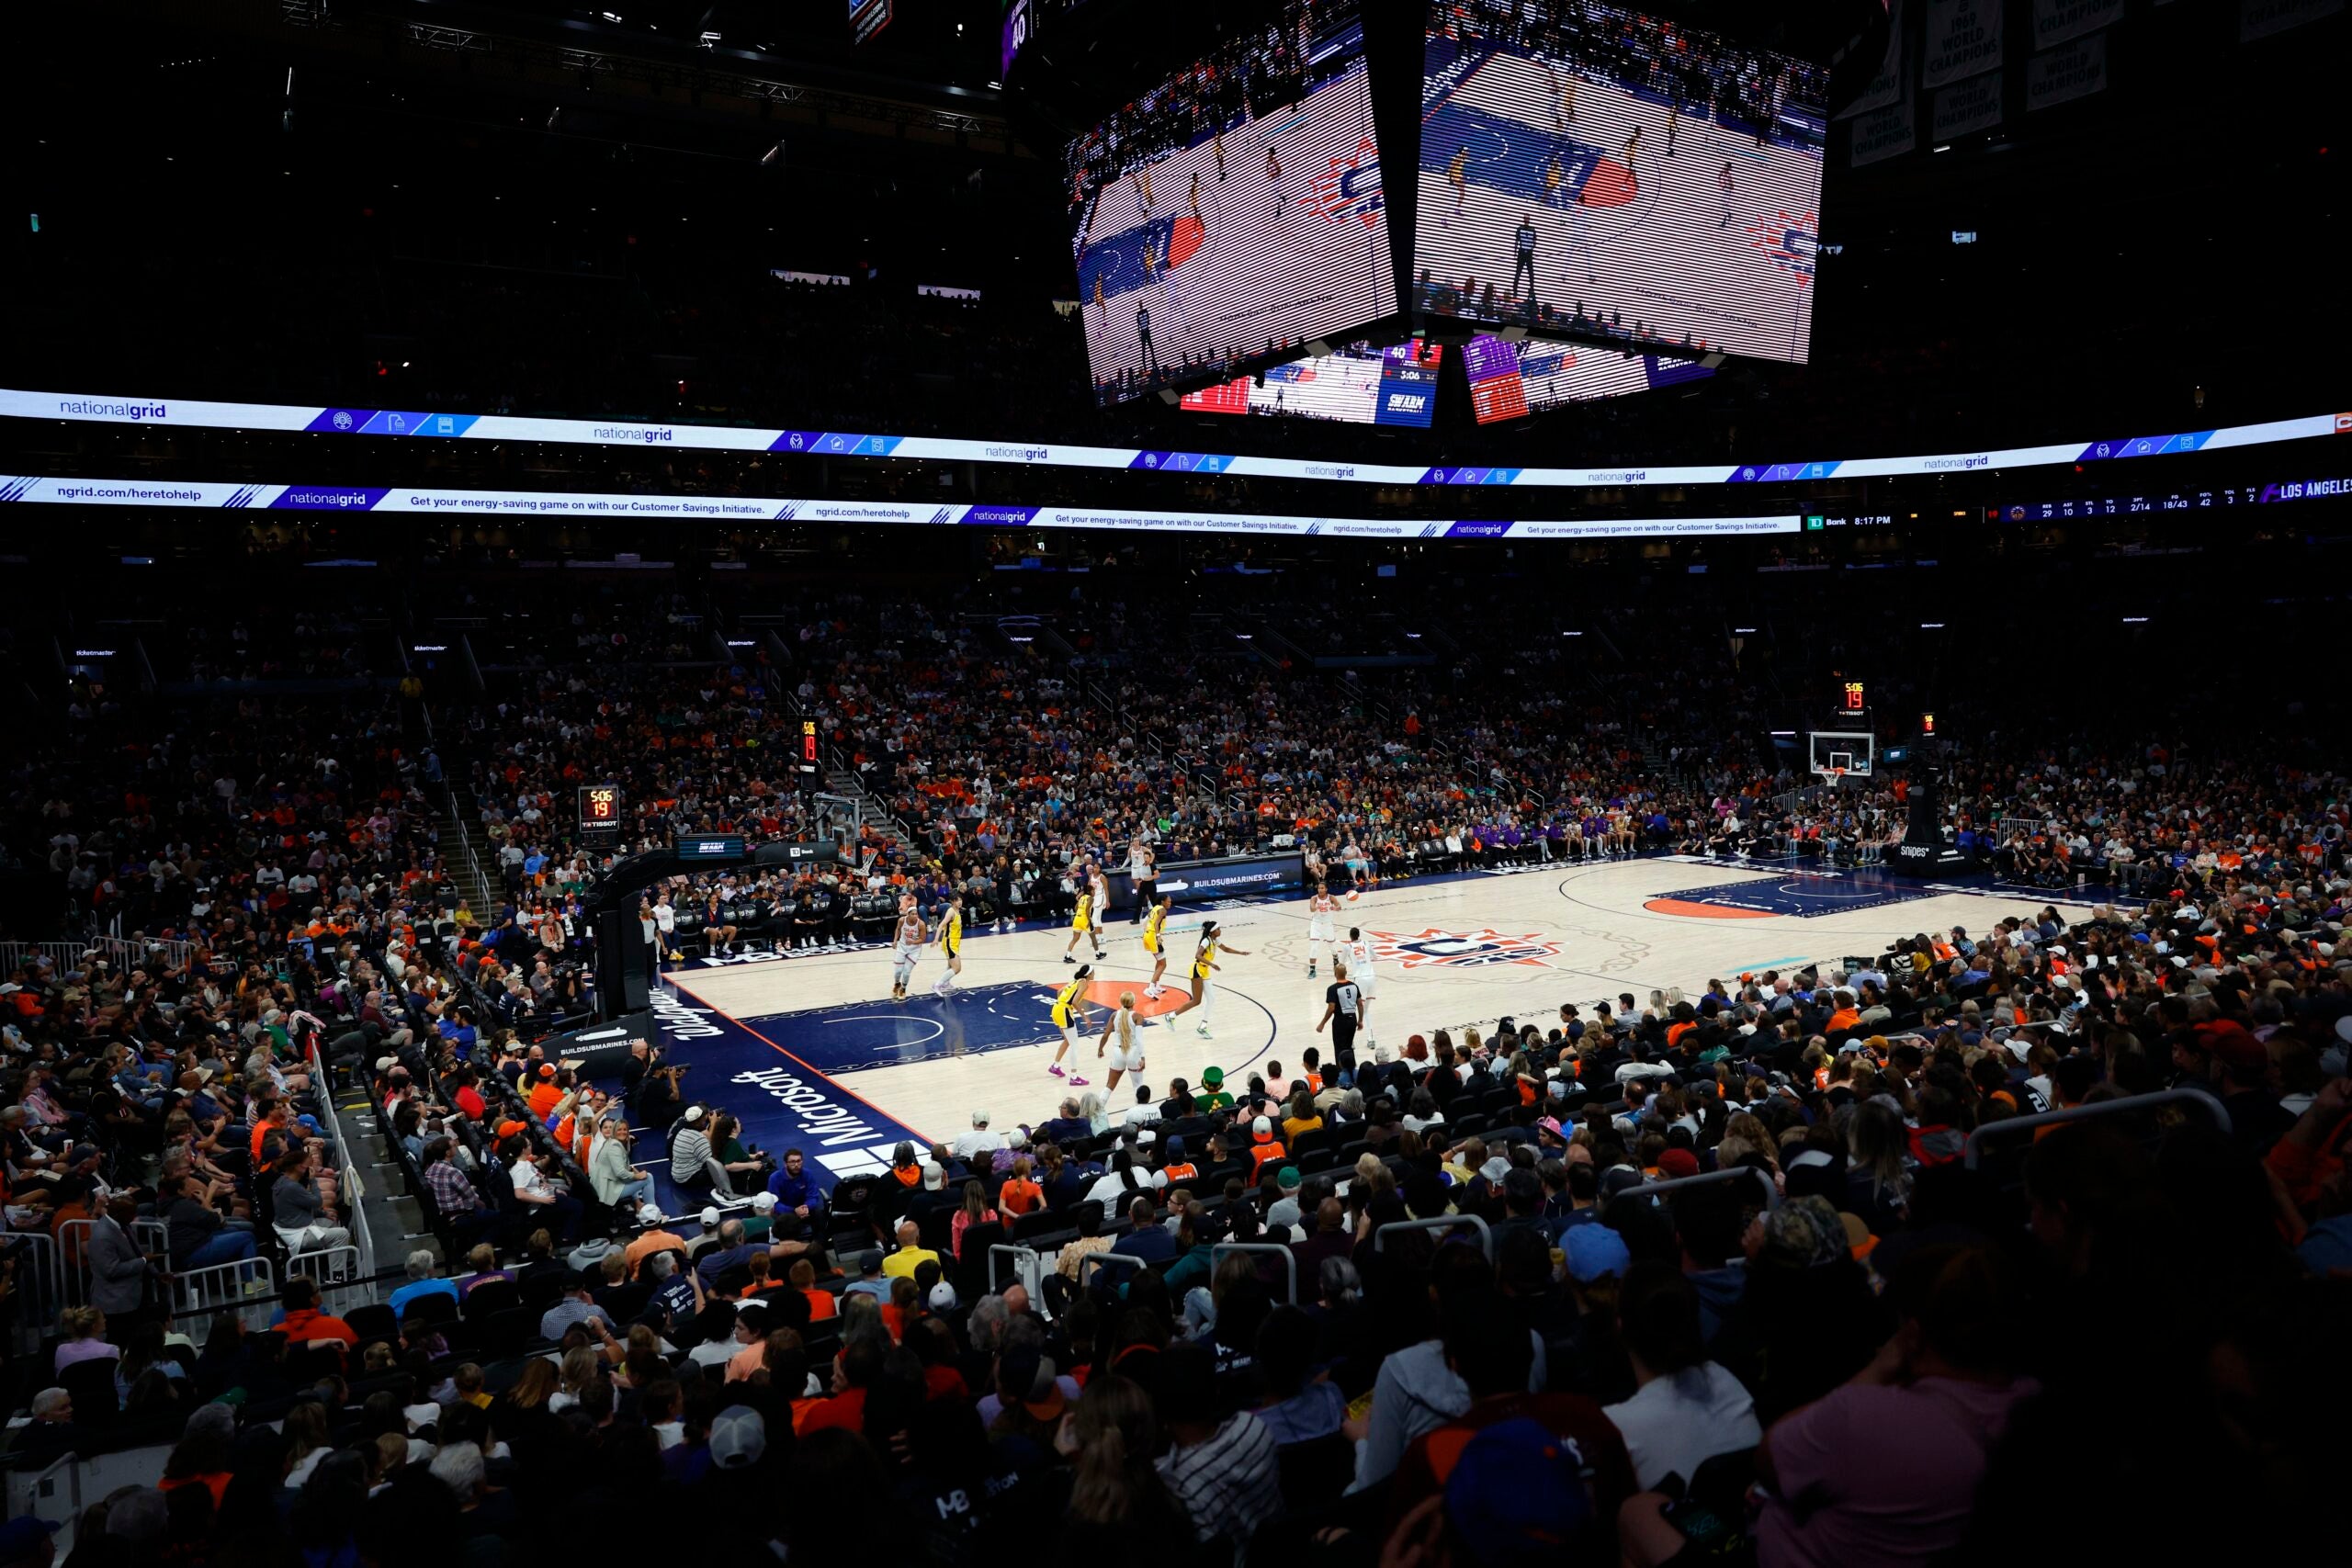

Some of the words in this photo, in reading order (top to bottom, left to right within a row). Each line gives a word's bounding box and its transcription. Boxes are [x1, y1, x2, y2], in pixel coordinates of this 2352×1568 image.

[1951, 13, 1976, 33] 1969
[1941, 28, 1984, 52] WORLD
[1930, 39, 1997, 73] CHAMPIONS
[2045, 52, 2088, 76] WORLD
[2031, 64, 2101, 96] CHAMPIONS
[1949, 89, 1986, 109] WORLD
[1937, 99, 1998, 129] CHAMPIONS
[1866, 116, 1901, 138] WORLD
[1856, 127, 1912, 154] CHAMPIONS
[1391, 347, 1406, 359] 40
[60, 400, 166, 419] nationalgrid
[594, 426, 673, 443] nationalgrid
[985, 446, 1047, 460] nationalgrid
[1924, 456, 1988, 469] nationalgrid
[1305, 464, 1354, 479] nationalgrid
[1589, 469, 1645, 482] nationalgrid
[57, 485, 202, 502] ngrid.com/heretohelp
[2280, 484, 2302, 499] LOS
[289, 492, 367, 508] nationalgrid
[411, 496, 431, 506] Get
[433, 498, 458, 509] your
[461, 498, 537, 511] energy-saving
[539, 502, 569, 512] game
[571, 502, 585, 510] on
[587, 500, 609, 511] with
[611, 503, 629, 512] our
[631, 502, 680, 513] Customer
[682, 503, 720, 516] Savings
[722, 504, 765, 514] Initiative.
[2042, 510, 2052, 518] 29
[2105, 505, 2116, 513] 12
[2131, 502, 2151, 512] 2/14
[2163, 501, 2188, 510] 18/43
[2200, 499, 2211, 507] 42
[2228, 496, 2233, 504] 3
[2248, 494, 2255, 502] 2
[816, 507, 910, 519] ngrid.com/heretohelp
[974, 510, 1026, 524] nationalgrid
[1854, 516, 1874, 525] 8:17
[1876, 515, 1891, 525] PM
[1056, 514, 1070, 524] Get
[1071, 517, 1089, 525] your
[1090, 516, 1142, 527] energy-saving
[1143, 519, 1163, 528] game
[1176, 518, 1192, 526] with
[1206, 518, 1239, 528] Customer
[1241, 520, 1268, 530] Savings
[1269, 521, 1299, 530] Initiative.
[1333, 524, 1403, 536] ngrid.com/heretohelp
[1527, 526, 1539, 535] Get
[1557, 526, 1610, 536] energy-saving
[1676, 524, 1713, 532] Customer
[1714, 523, 1745, 532] Savings
[1745, 522, 1781, 531] Initiative.
[1808, 518, 1823, 528] TD
[1826, 517, 1847, 526] Bank
[1456, 525, 1502, 536] nationalgrid
[76, 649, 116, 657] ticketmaster
[1845, 682, 1864, 693] 5:06
[1848, 692, 1862, 708] 19
[804, 721, 816, 735] 5:06
[805, 736, 816, 761] 19
[591, 790, 613, 803] 5:06
[594, 802, 608, 817] 19
[1901, 845, 1926, 858] snipes
[1194, 872, 1281, 888] BUILDSUBMARINES.COM
[782, 942, 897, 959] BOSTO
[1344, 988, 1352, 999] 9
[560, 1037, 645, 1055] BUILDSUBMARINES.COM
[730, 1066, 885, 1146] Microsoft
